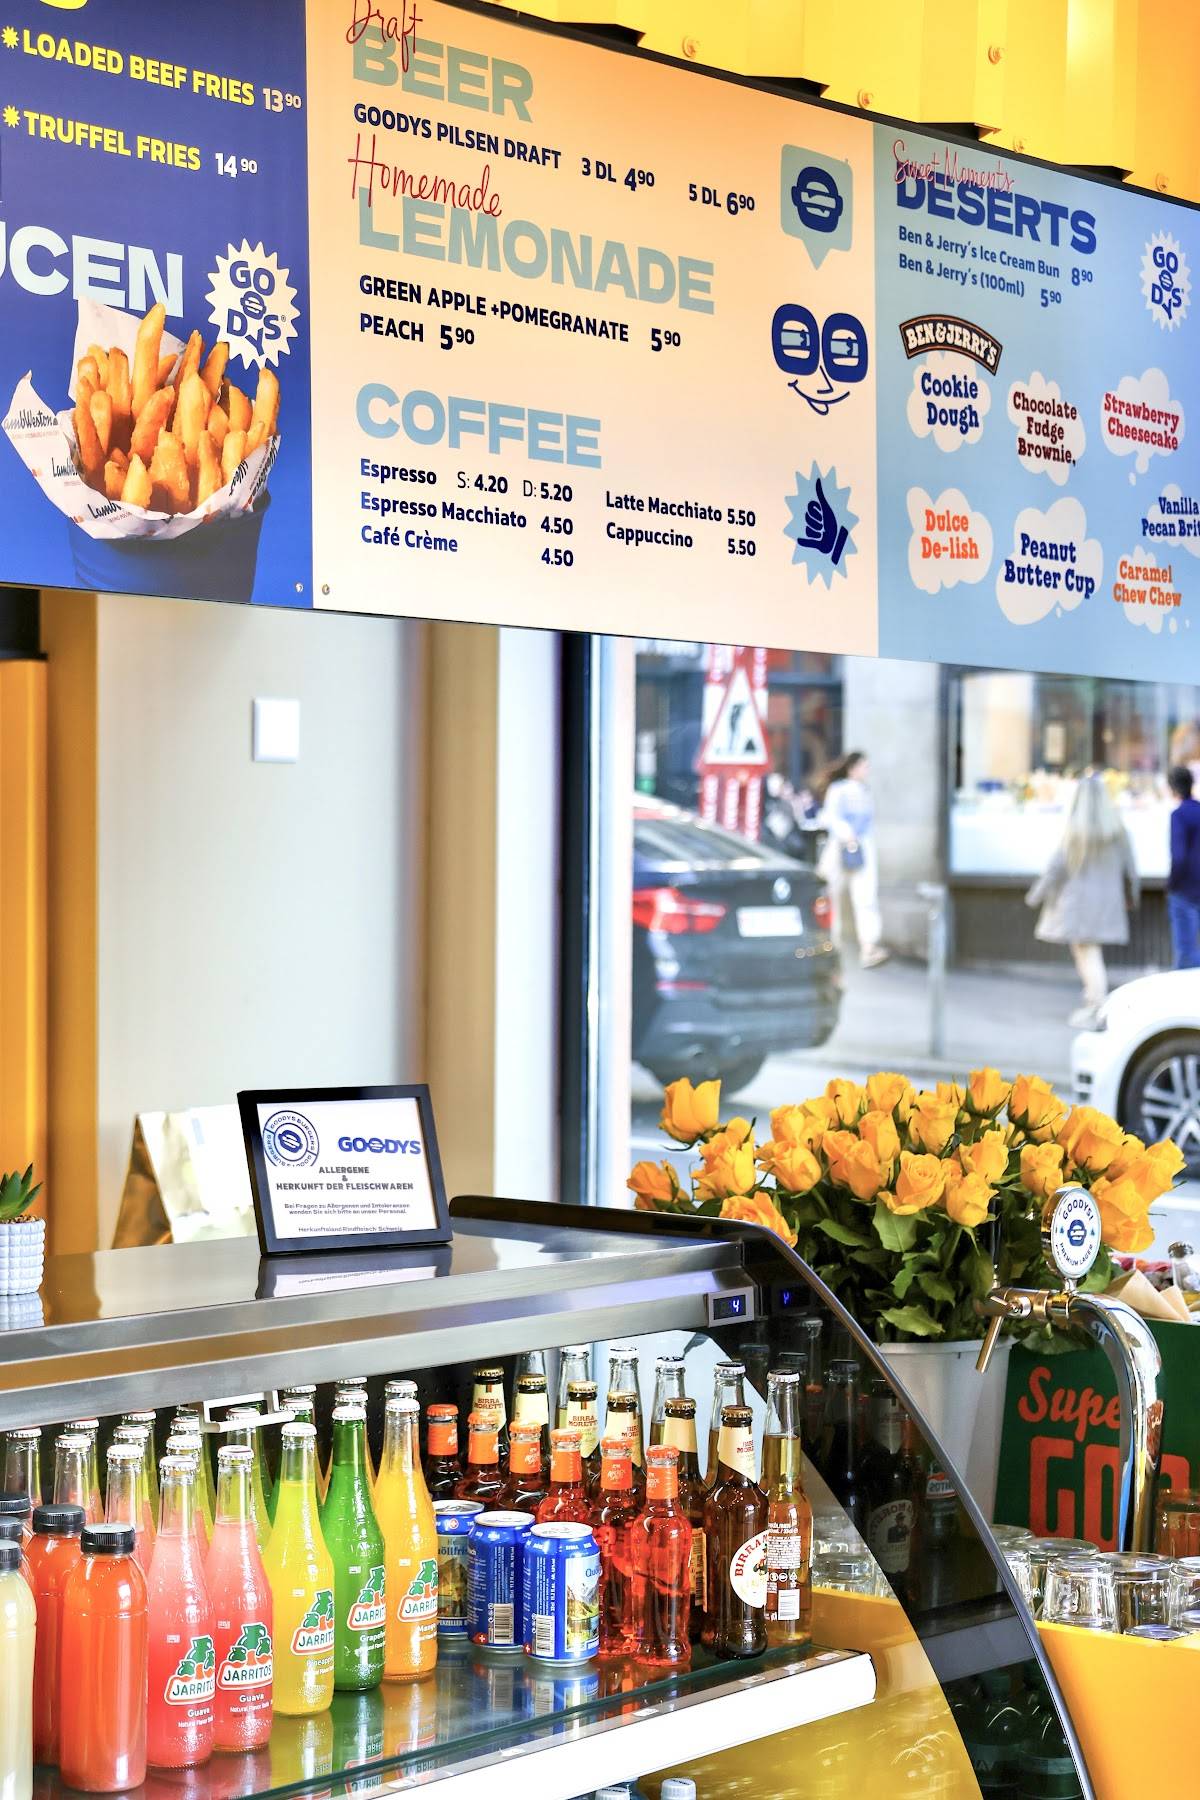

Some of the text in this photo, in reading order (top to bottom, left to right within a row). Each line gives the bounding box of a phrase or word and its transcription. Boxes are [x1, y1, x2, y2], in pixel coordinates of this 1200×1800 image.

[346, 0, 424, 73] Draft
[22, 29, 124, 75] LOADED
[129, 55, 188, 89] BEEF
[192, 70, 255, 106] FRIES
[353, 22, 534, 124] BEER
[24, 110, 132, 156] TRUFFEL
[136, 135, 201, 171] FRIES
[353, 103, 432, 139] GOODYS
[437, 121, 499, 155] PILSEN
[503, 138, 561, 169] DRAFT
[581, 157, 591, 176] 3
[595, 160, 617, 183] DL
[348, 133, 502, 217] Homemade
[893, 139, 940, 188] Sweet
[688, 183, 698, 201] 5
[701, 187, 721, 208] DL
[896, 160, 1098, 255] DESERTS
[358, 186, 715, 315] LEMONADE
[899, 225, 922, 246] Ben
[925, 232, 934, 247] &
[980, 245, 997, 263] Ice
[999, 249, 1035, 273] Cream
[1038, 259, 1060, 278] Bun
[899, 253, 922, 273] Ben
[925, 260, 934, 274] &
[980, 273, 1025, 297] (100ml)
[360, 274, 422, 304] GREEN
[427, 287, 487, 315] APPLE
[360, 312, 424, 342] PEACH
[921, 372, 978, 399] Cookie
[927, 402, 979, 435] Dough
[1013, 391, 1077, 420] Chocolate
[1103, 393, 1180, 433] Strawberry
[356, 382, 602, 469] COFFEE
[1026, 417, 1065, 445] Fudge
[1107, 417, 1179, 451] Cheesecake
[360, 458, 437, 484] Espresso
[474, 474, 509, 494] 4.20
[540, 482, 573, 502] 5.20
[360, 491, 574, 535] Espresso Macchiato 4.50
[606, 490, 756, 527] Latte Macchiato 5.50
[925, 509, 969, 532] Dulce
[1158, 496, 1200, 515] Vanilla
[361, 525, 574, 567] Café Crème 4.50
[606, 521, 756, 557] Cappuccino 5.50
[1141, 518, 1176, 537] Pecan
[921, 537, 979, 560] De-lish
[1021, 533, 1077, 563] Peanut
[1004, 560, 1096, 600] Butter Cup
[1119, 560, 1173, 584] Caramel
[1113, 584, 1182, 607] Chew Chew
[318, 1166, 370, 1174] ALLERGENE
[341, 1174, 348, 1182] &
[1018, 1366, 1120, 1442] Supe
[735, 1539, 762, 1577] BIRRA
[224, 1665, 271, 1681] JARRITOS
[187, 1708, 210, 1717] Guava
[239, 1693, 265, 1702] Guava
